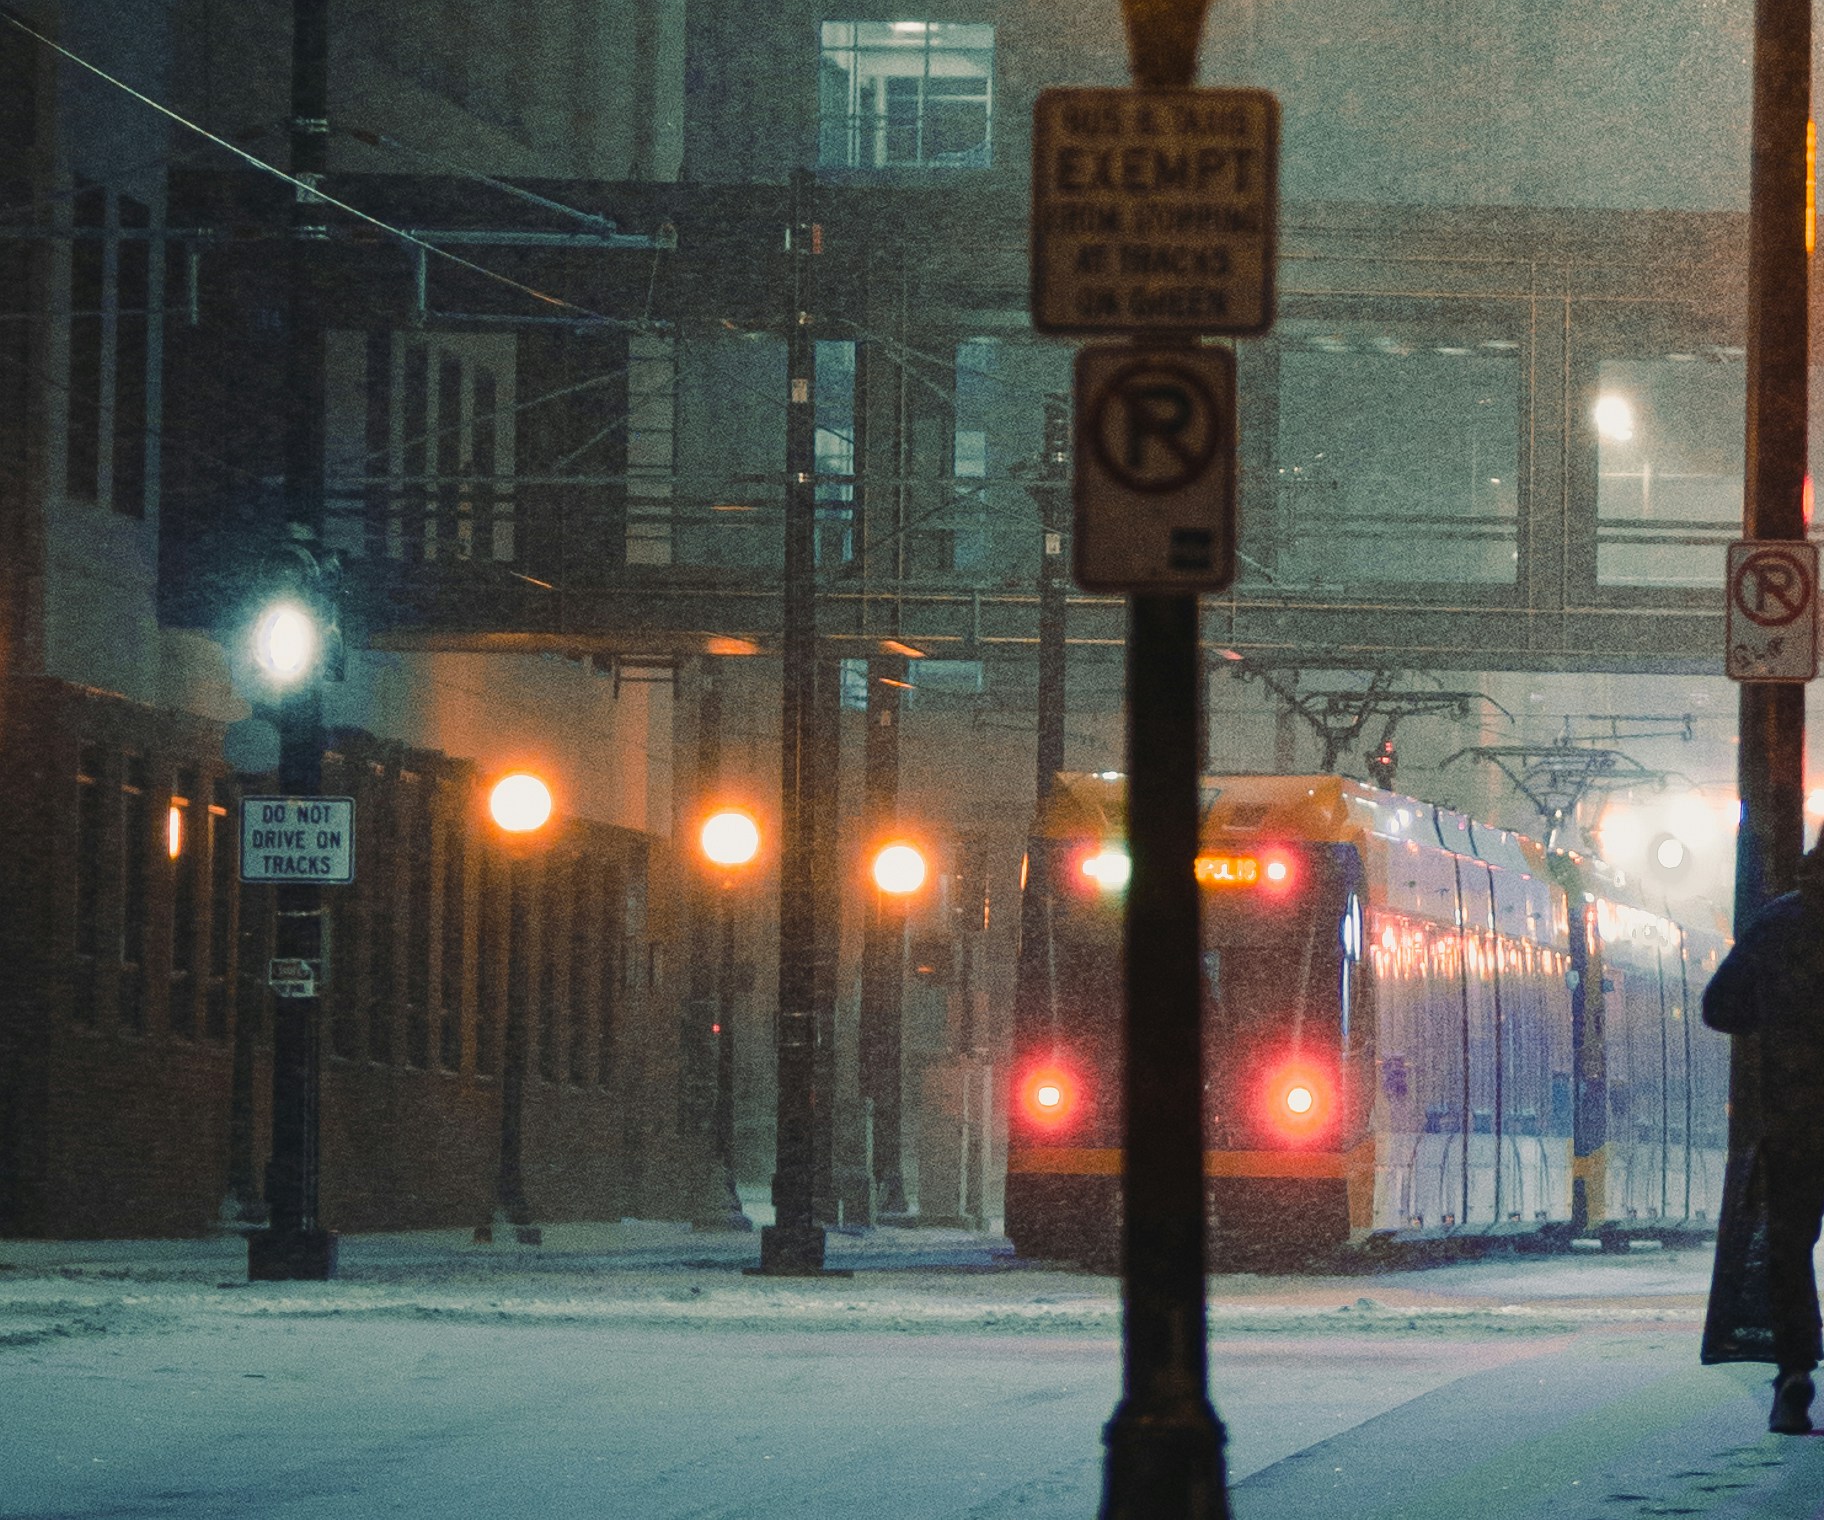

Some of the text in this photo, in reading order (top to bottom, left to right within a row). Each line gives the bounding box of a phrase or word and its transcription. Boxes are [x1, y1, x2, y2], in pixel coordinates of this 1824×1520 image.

[1056, 147, 1258, 193] EXEMPT
[262, 805, 332, 823] DO NOT
[252, 830, 342, 849] DRIVE ON
[263, 855, 332, 874] TRACKS
